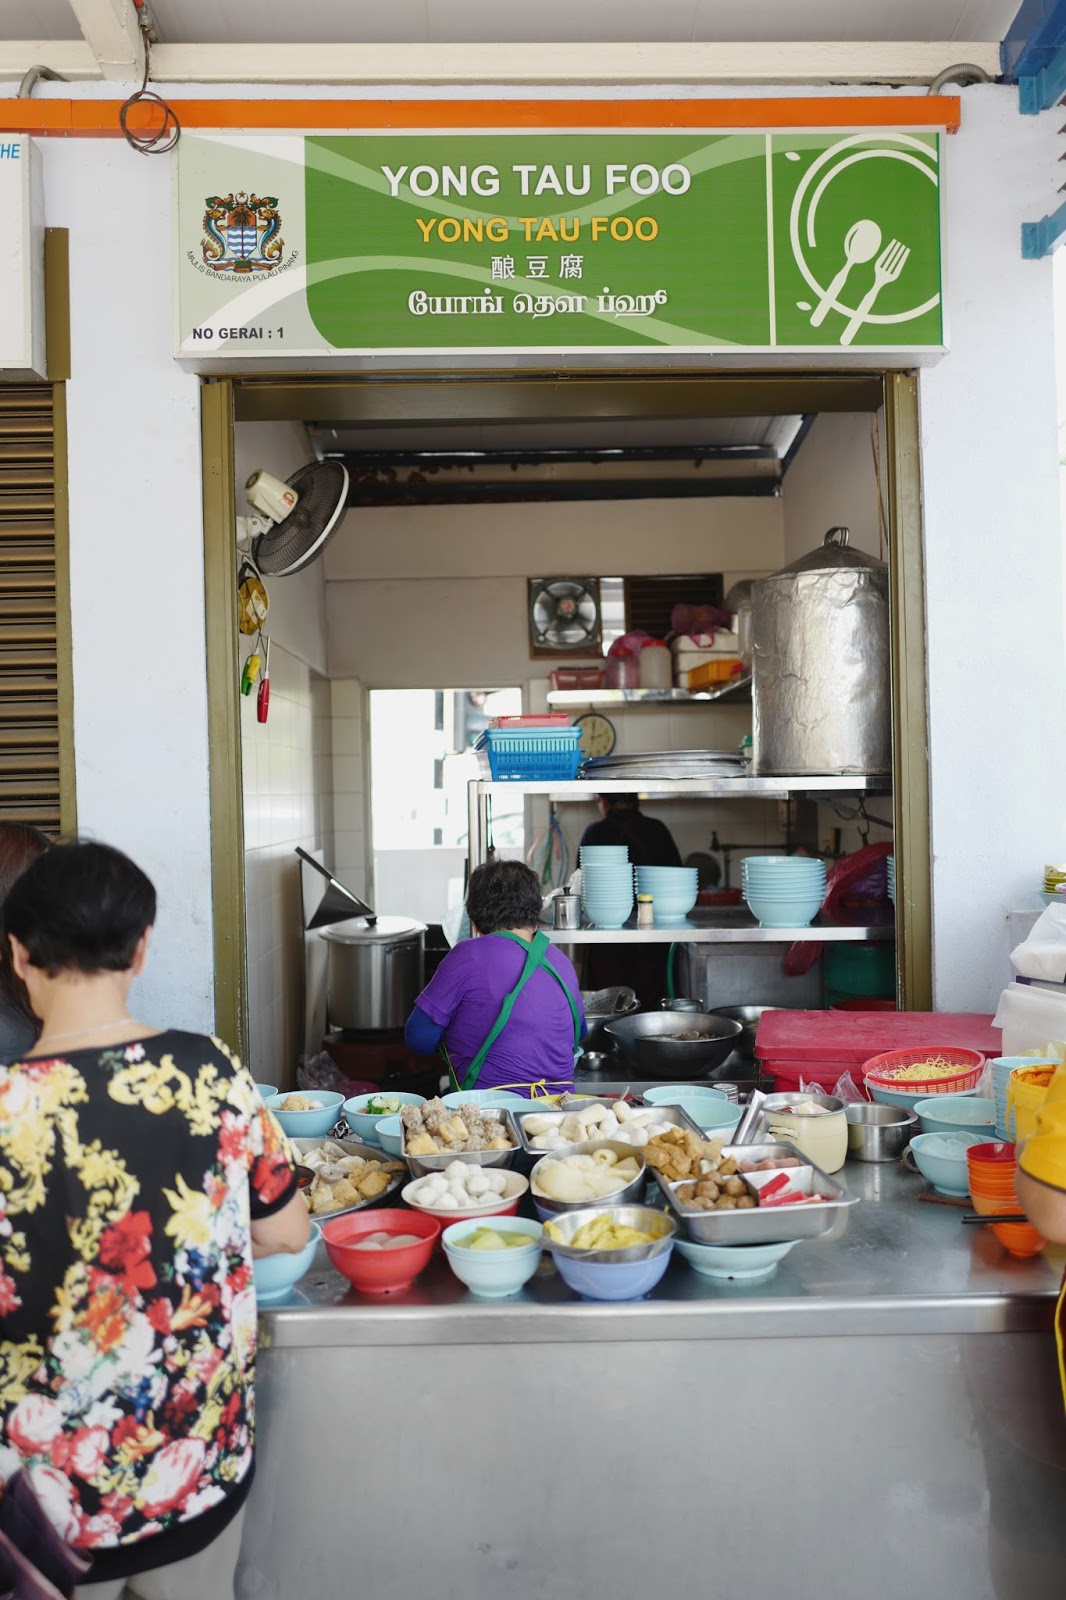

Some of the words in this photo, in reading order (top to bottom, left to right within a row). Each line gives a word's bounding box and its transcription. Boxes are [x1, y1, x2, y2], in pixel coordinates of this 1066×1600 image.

[0, 143, 21, 159] HE
[381, 165, 500, 197] YONG
[512, 164, 591, 196] TAU
[606, 163, 691, 196] FOO
[415, 218, 509, 243] YONG
[518, 217, 580, 242] TAU
[591, 216, 659, 242] FOO
[186, 250, 206, 273] MAJLIS
[205, 269, 252, 283] BANDARAYA
[252, 270, 278, 282] PULAU
[278, 249, 299, 274] PINANG
[490, 253, 584, 280] 酿豆腐
[192, 328, 214, 340] NO
[218, 327, 263, 339] GERAI
[277, 327, 284, 339] 1
